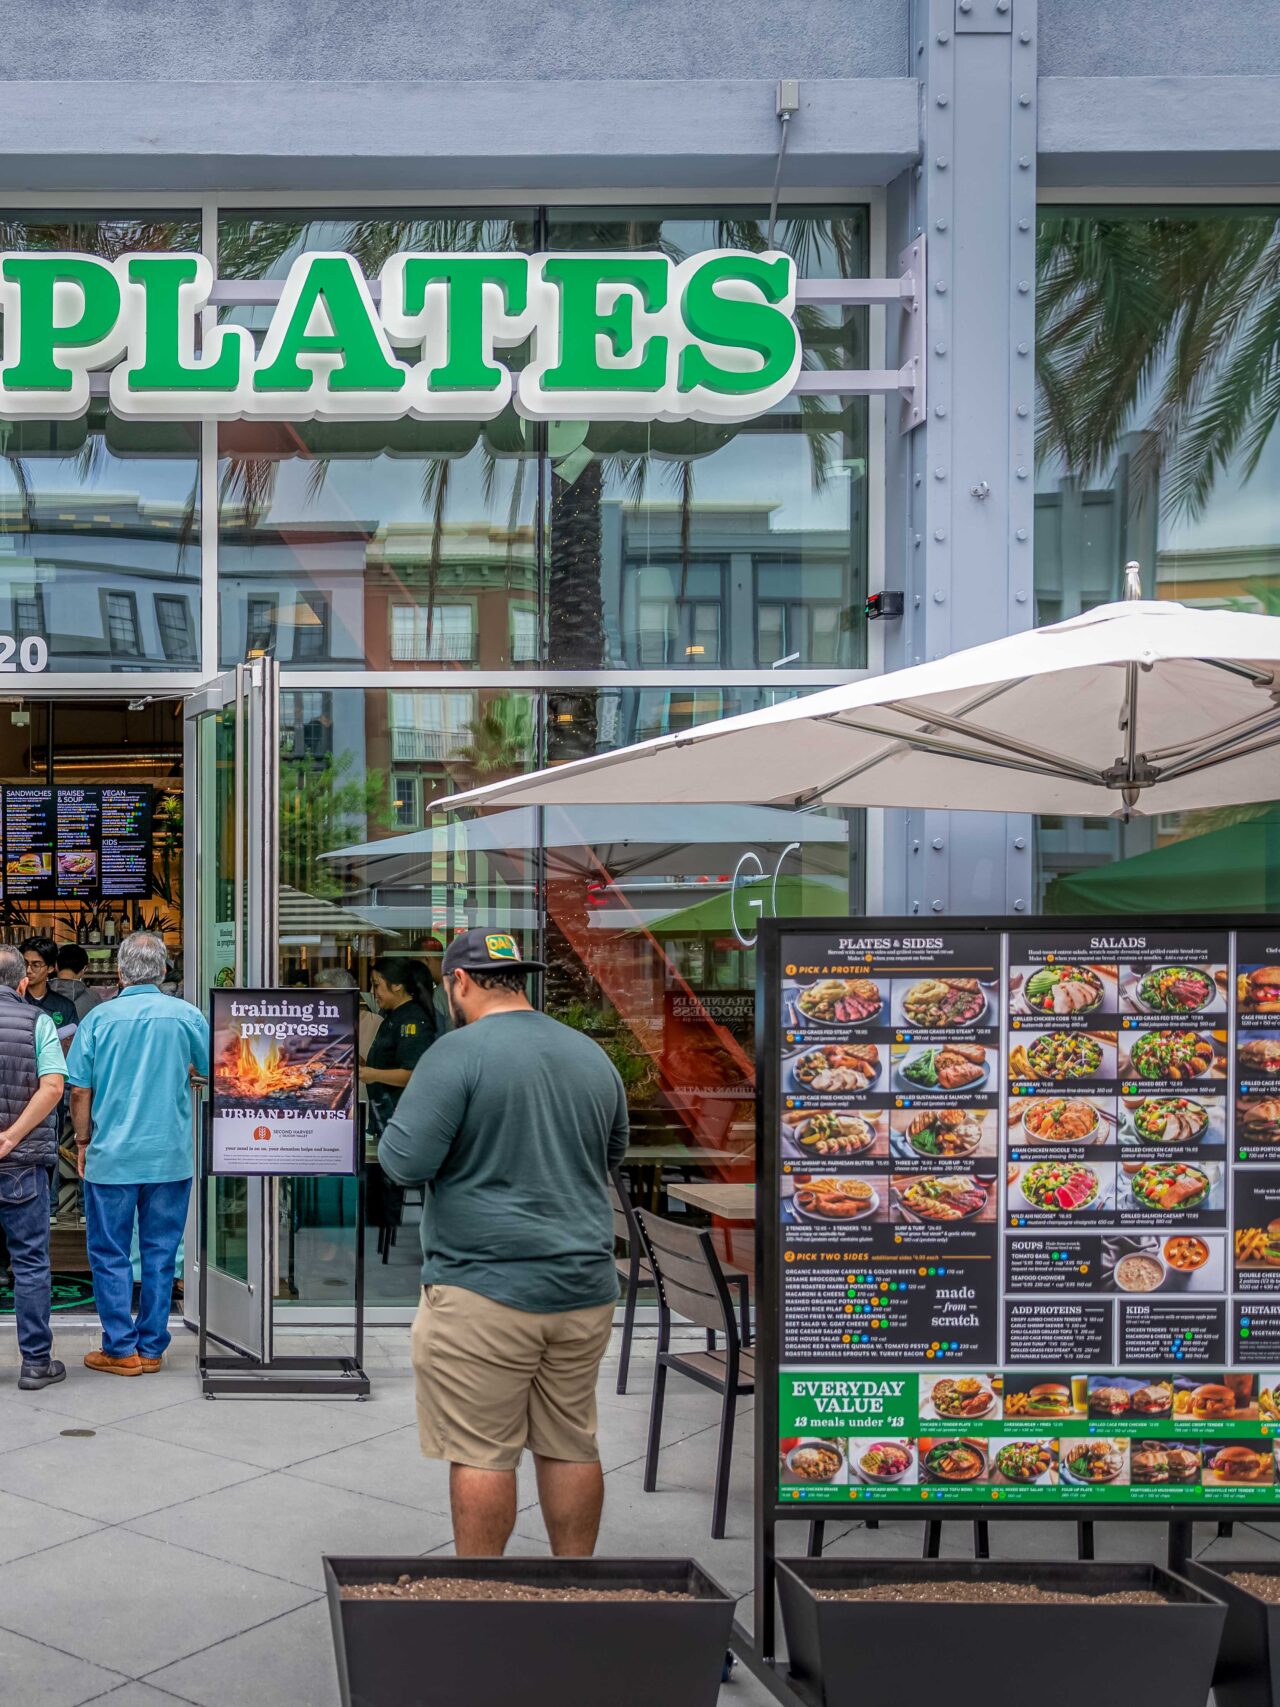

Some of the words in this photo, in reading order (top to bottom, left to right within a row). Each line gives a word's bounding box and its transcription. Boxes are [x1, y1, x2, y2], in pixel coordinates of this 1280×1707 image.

[1, 254, 797, 395] PLATES
[839, 938, 891, 949] PLATES
[892, 940, 900, 948] &
[902, 938, 943, 949] SIDES
[1090, 937, 1146, 948] SALADS
[799, 966, 820, 974] PICK
[822, 966, 829, 974] A
[832, 966, 870, 974] PROTEIN
[230, 1000, 314, 1021] training
[318, 1000, 340, 1018] in
[241, 1021, 329, 1039] progress
[221, 1108, 279, 1120] URBAN
[284, 1109, 346, 1120] PLATES
[1012, 1241, 1043, 1250] SOUPS
[936, 1287, 975, 1298] made
[942, 1302, 967, 1312] from
[1012, 1306, 1033, 1314] ADD
[1034, 1306, 1082, 1314] PROTEINS
[1126, 1306, 1150, 1314] KIDS
[931, 1314, 979, 1326] scratch
[792, 1381, 905, 1397] EVERYDAY
[814, 1398, 883, 1413] VALUE
[794, 1417, 808, 1428] 13
[810, 1417, 845, 1428] meals
[849, 1417, 883, 1428] under
[888, 1416, 905, 1428] $13
